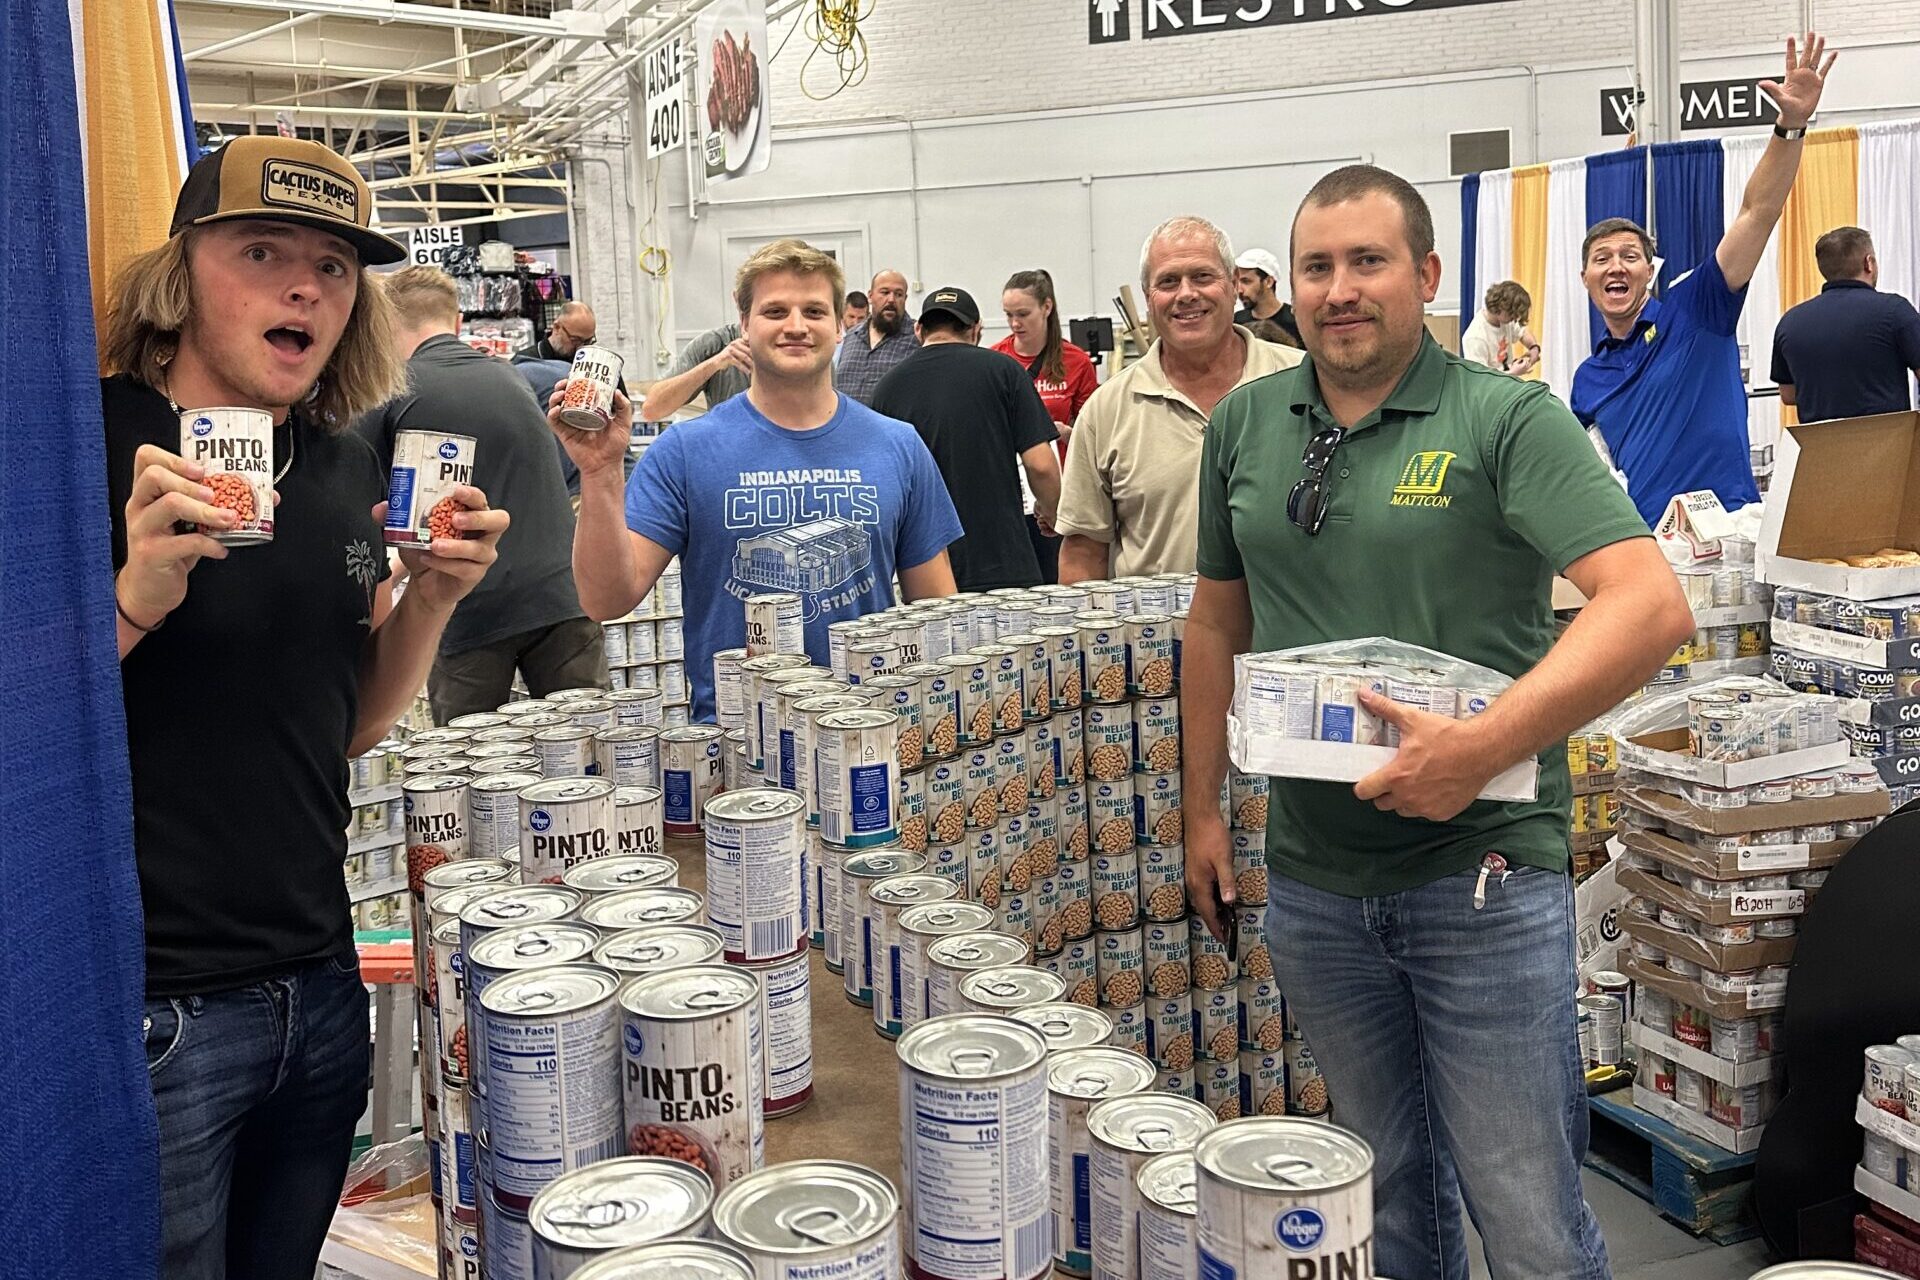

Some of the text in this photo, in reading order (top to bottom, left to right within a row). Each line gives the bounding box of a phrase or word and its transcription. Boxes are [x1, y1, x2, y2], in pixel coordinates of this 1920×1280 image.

[648, 37, 681, 100] AISLE
[1608, 84, 1782, 125] WMEN
[650, 98, 680, 151] 400
[269, 169, 355, 207] CACTUS ROPES
[284, 187, 344, 210] TEXAS
[413, 227, 460, 244] AISLE
[415, 248, 442, 265] 60
[573, 361, 610, 377] PINTO
[195, 438, 263, 460] PINTO
[224, 458, 268, 473] BEANS
[739, 469, 862, 486] INDIANAPOLIS
[724, 484, 880, 529] COLTS
[1390, 494, 1453, 508] MATTCON
[901, 654, 921, 664] EANS
[1792, 659, 1816, 672] OYA
[1858, 672, 1894, 684] GOYA
[1853, 730, 1881, 743] OYA
[405, 812, 457, 833] PINTO
[720, 825, 740, 834] Facts
[423, 827, 463, 844] BEANS
[533, 828, 606, 859] PINTO
[617, 825, 655, 850] NTO
[727, 851, 741, 860] 110
[767, 967, 798, 981] Nutrition
[768, 997, 793, 1007] Calories
[524, 1024, 556, 1036] Facts
[535, 1058, 557, 1071] 110
[626, 1058, 724, 1101] PINTO
[914, 1082, 999, 1101] Nutrition Facts
[660, 1092, 734, 1123] BEANS
[916, 1122, 999, 1141] Calories 110
[1281, 1213, 1321, 1245] Kroger
[788, 1246, 885, 1280] Nutrition Facts
[1287, 1234, 1372, 1280] PINT
